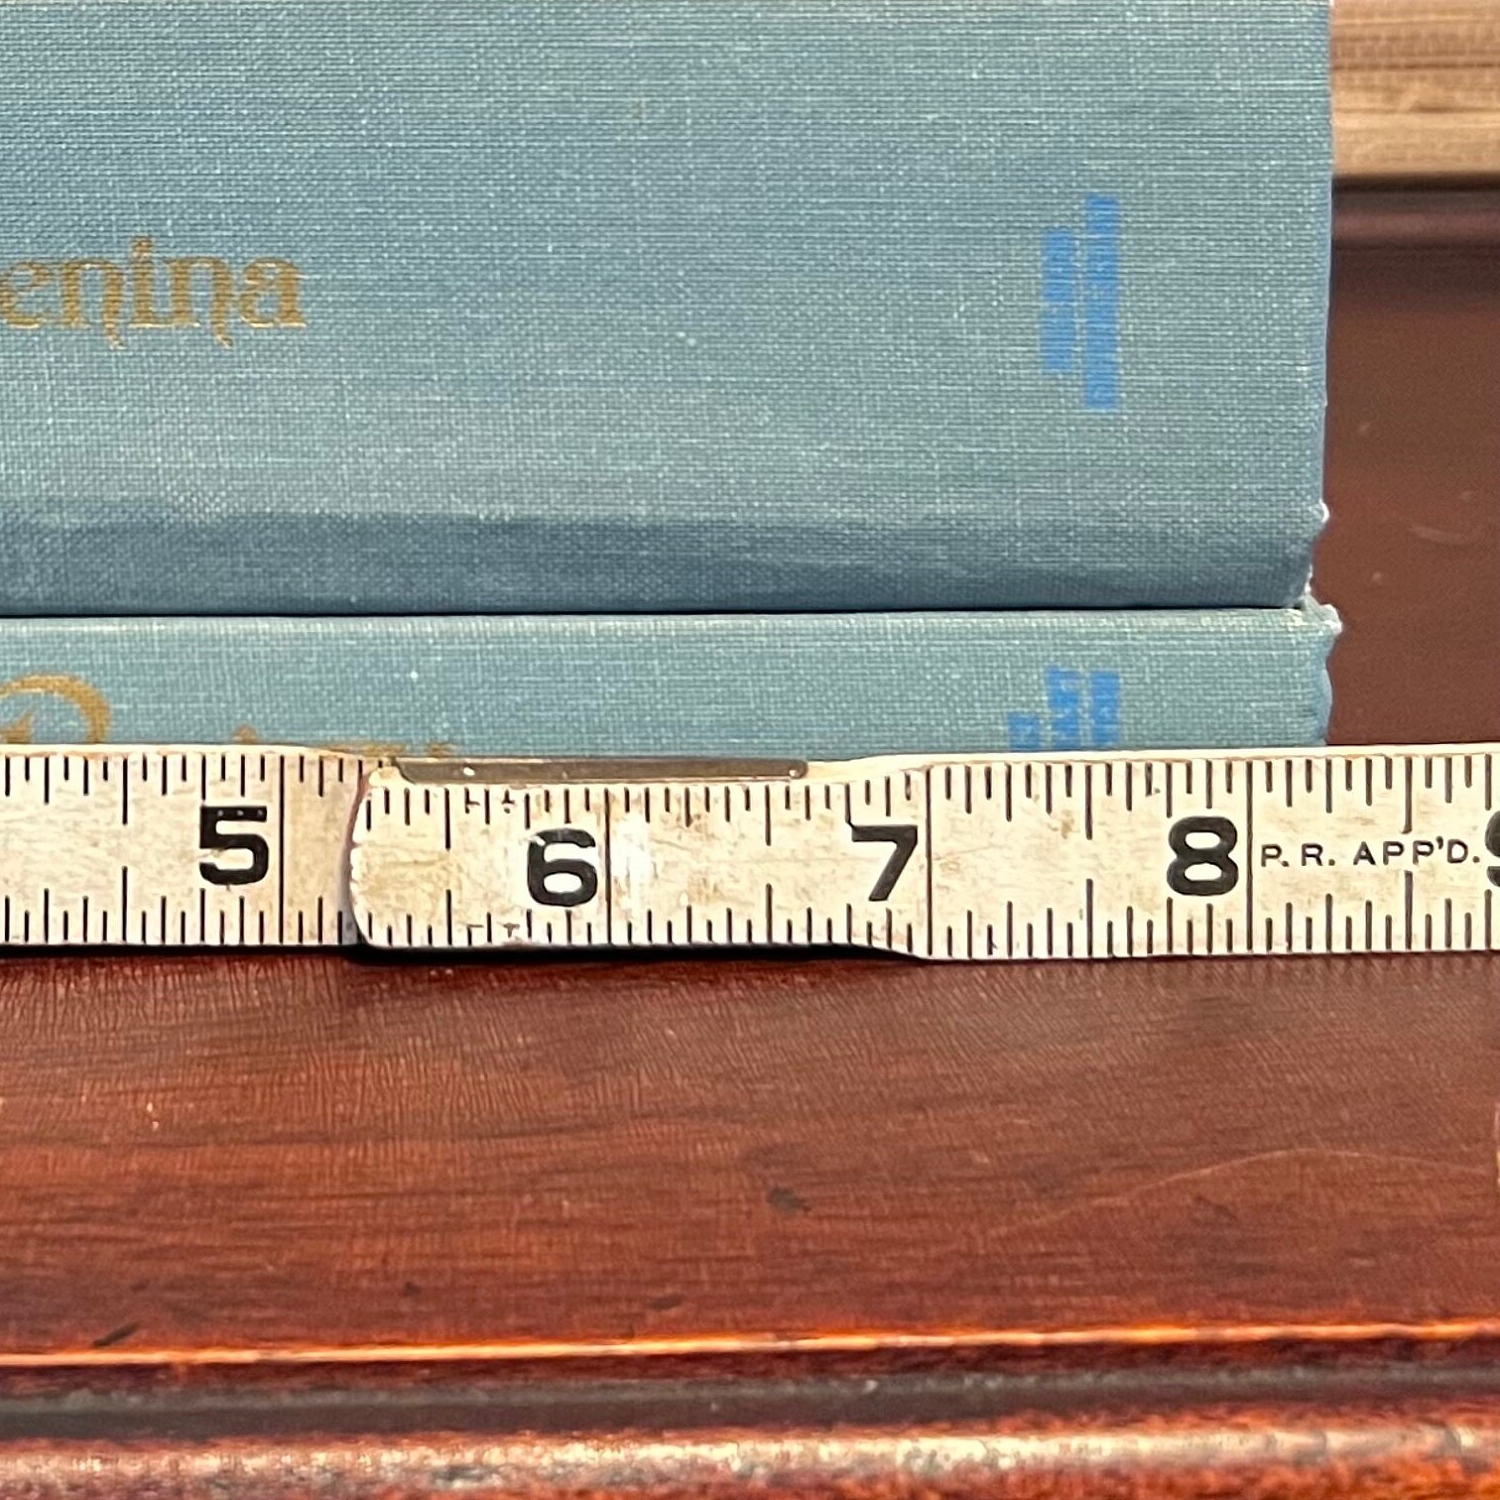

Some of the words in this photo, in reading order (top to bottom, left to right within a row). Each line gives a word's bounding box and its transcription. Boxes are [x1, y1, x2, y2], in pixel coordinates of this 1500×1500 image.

[199, 805, 269, 886] 5
[526, 828, 598, 908] 6
[851, 824, 919, 902] 7
[1166, 815, 1240, 896] 8
[1352, 835, 1481, 867] APP'D.
